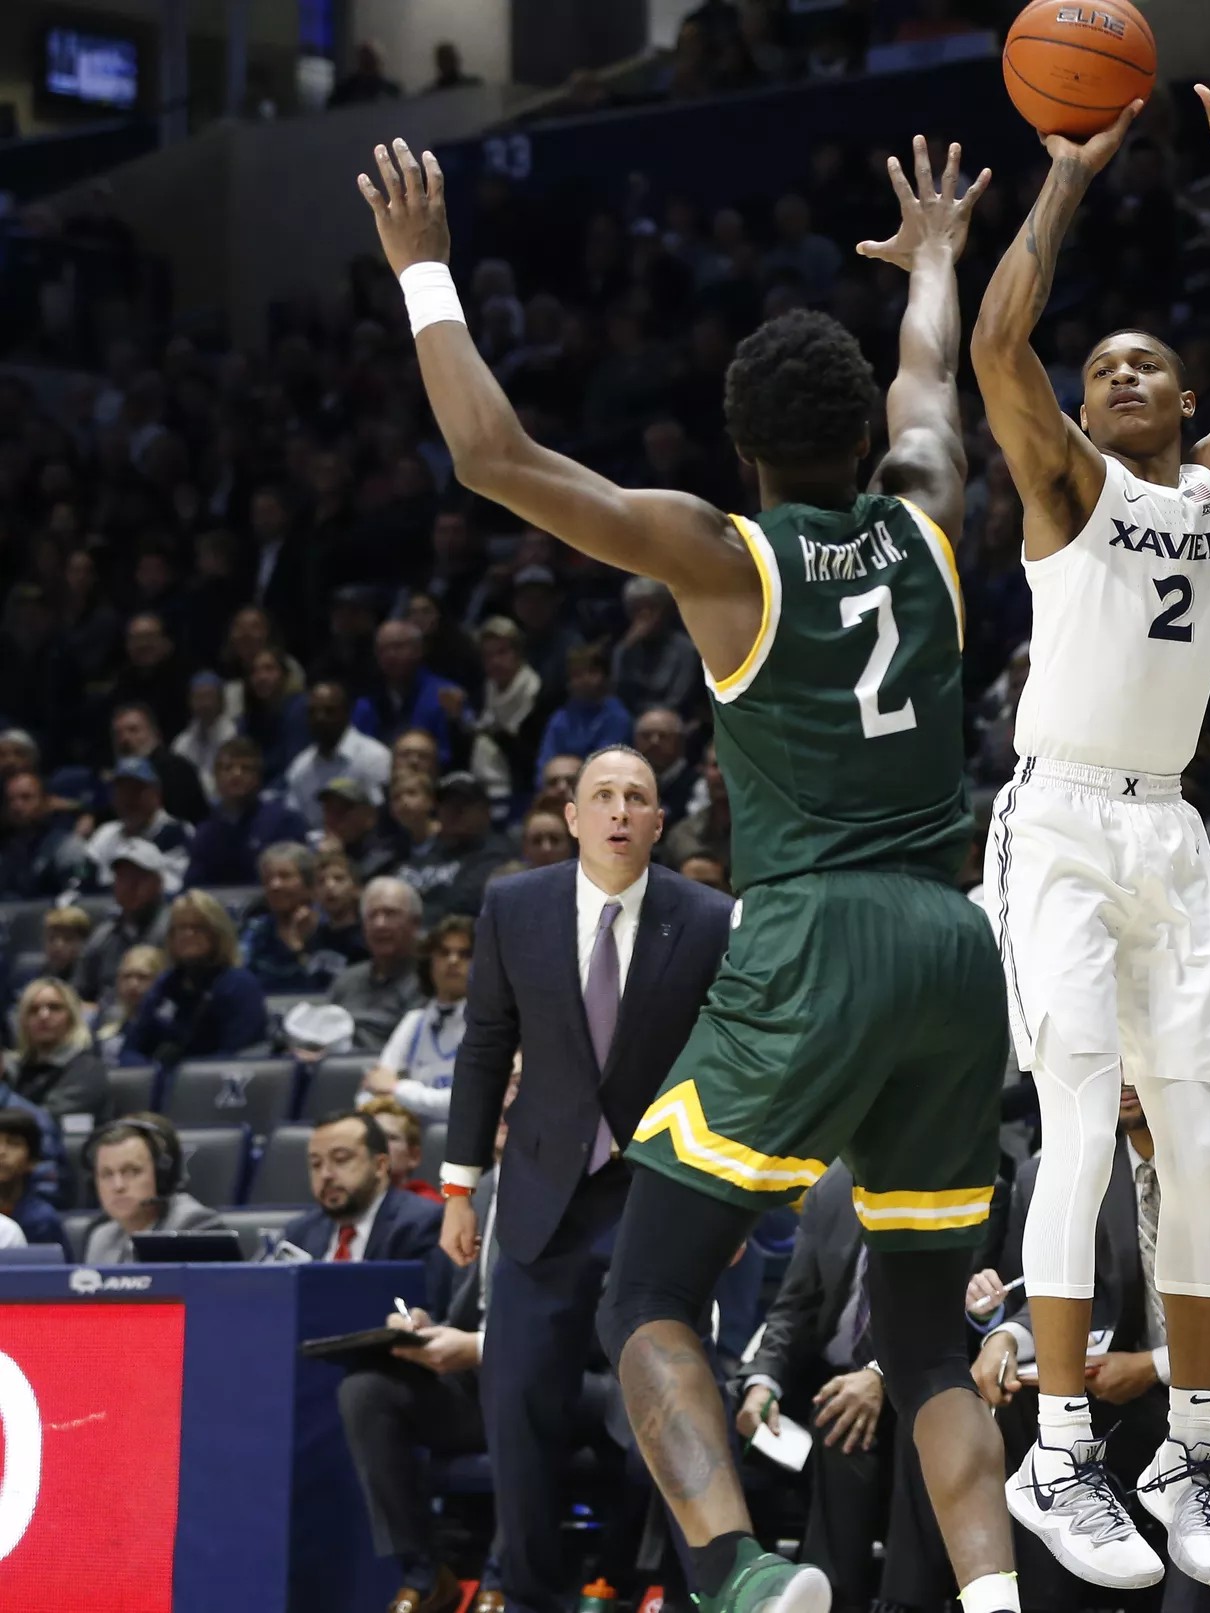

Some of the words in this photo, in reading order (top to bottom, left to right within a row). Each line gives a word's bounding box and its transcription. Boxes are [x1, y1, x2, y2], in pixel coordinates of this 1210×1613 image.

[1056, 7, 1126, 36] ELITE
[868, 521, 908, 570] JR.
[1148, 574, 1195, 643] 2
[839, 584, 918, 739] 2
[1121, 777, 1140, 797] X
